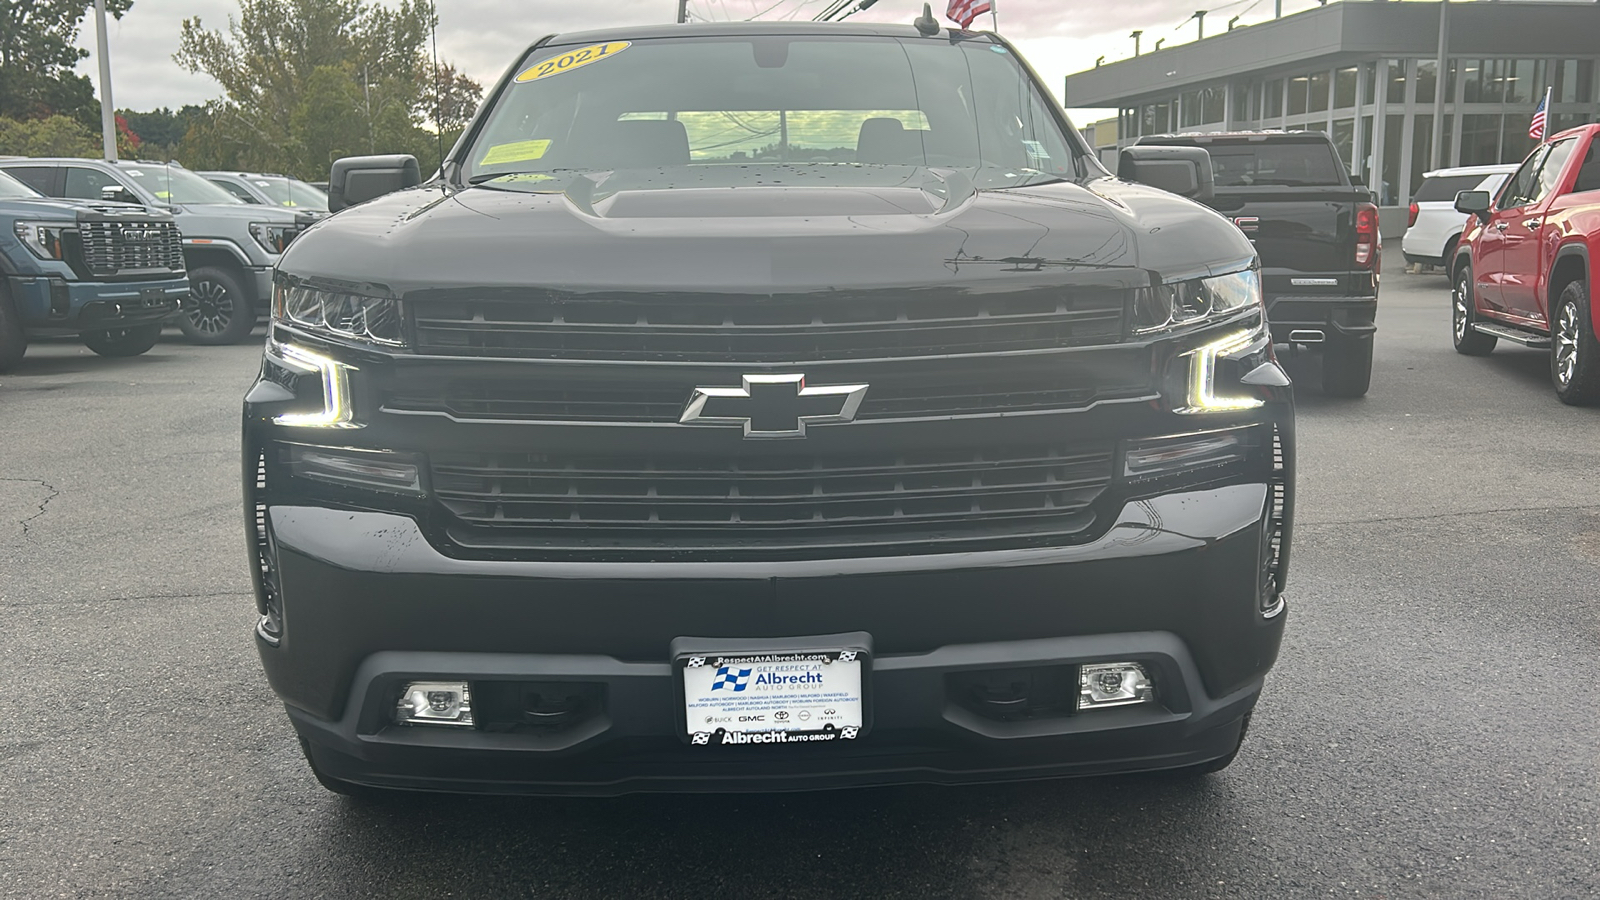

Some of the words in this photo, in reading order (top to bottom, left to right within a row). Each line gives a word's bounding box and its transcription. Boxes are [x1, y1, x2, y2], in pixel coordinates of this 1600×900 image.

[537, 44, 610, 77] 2021
[717, 654, 827, 664] RespectAtAlbrecht.com
[775, 664, 809, 672] RESPECT
[755, 671, 823, 685] Albrecht
[721, 731, 787, 744] Albrecht
[808, 733, 836, 741] GROUP
